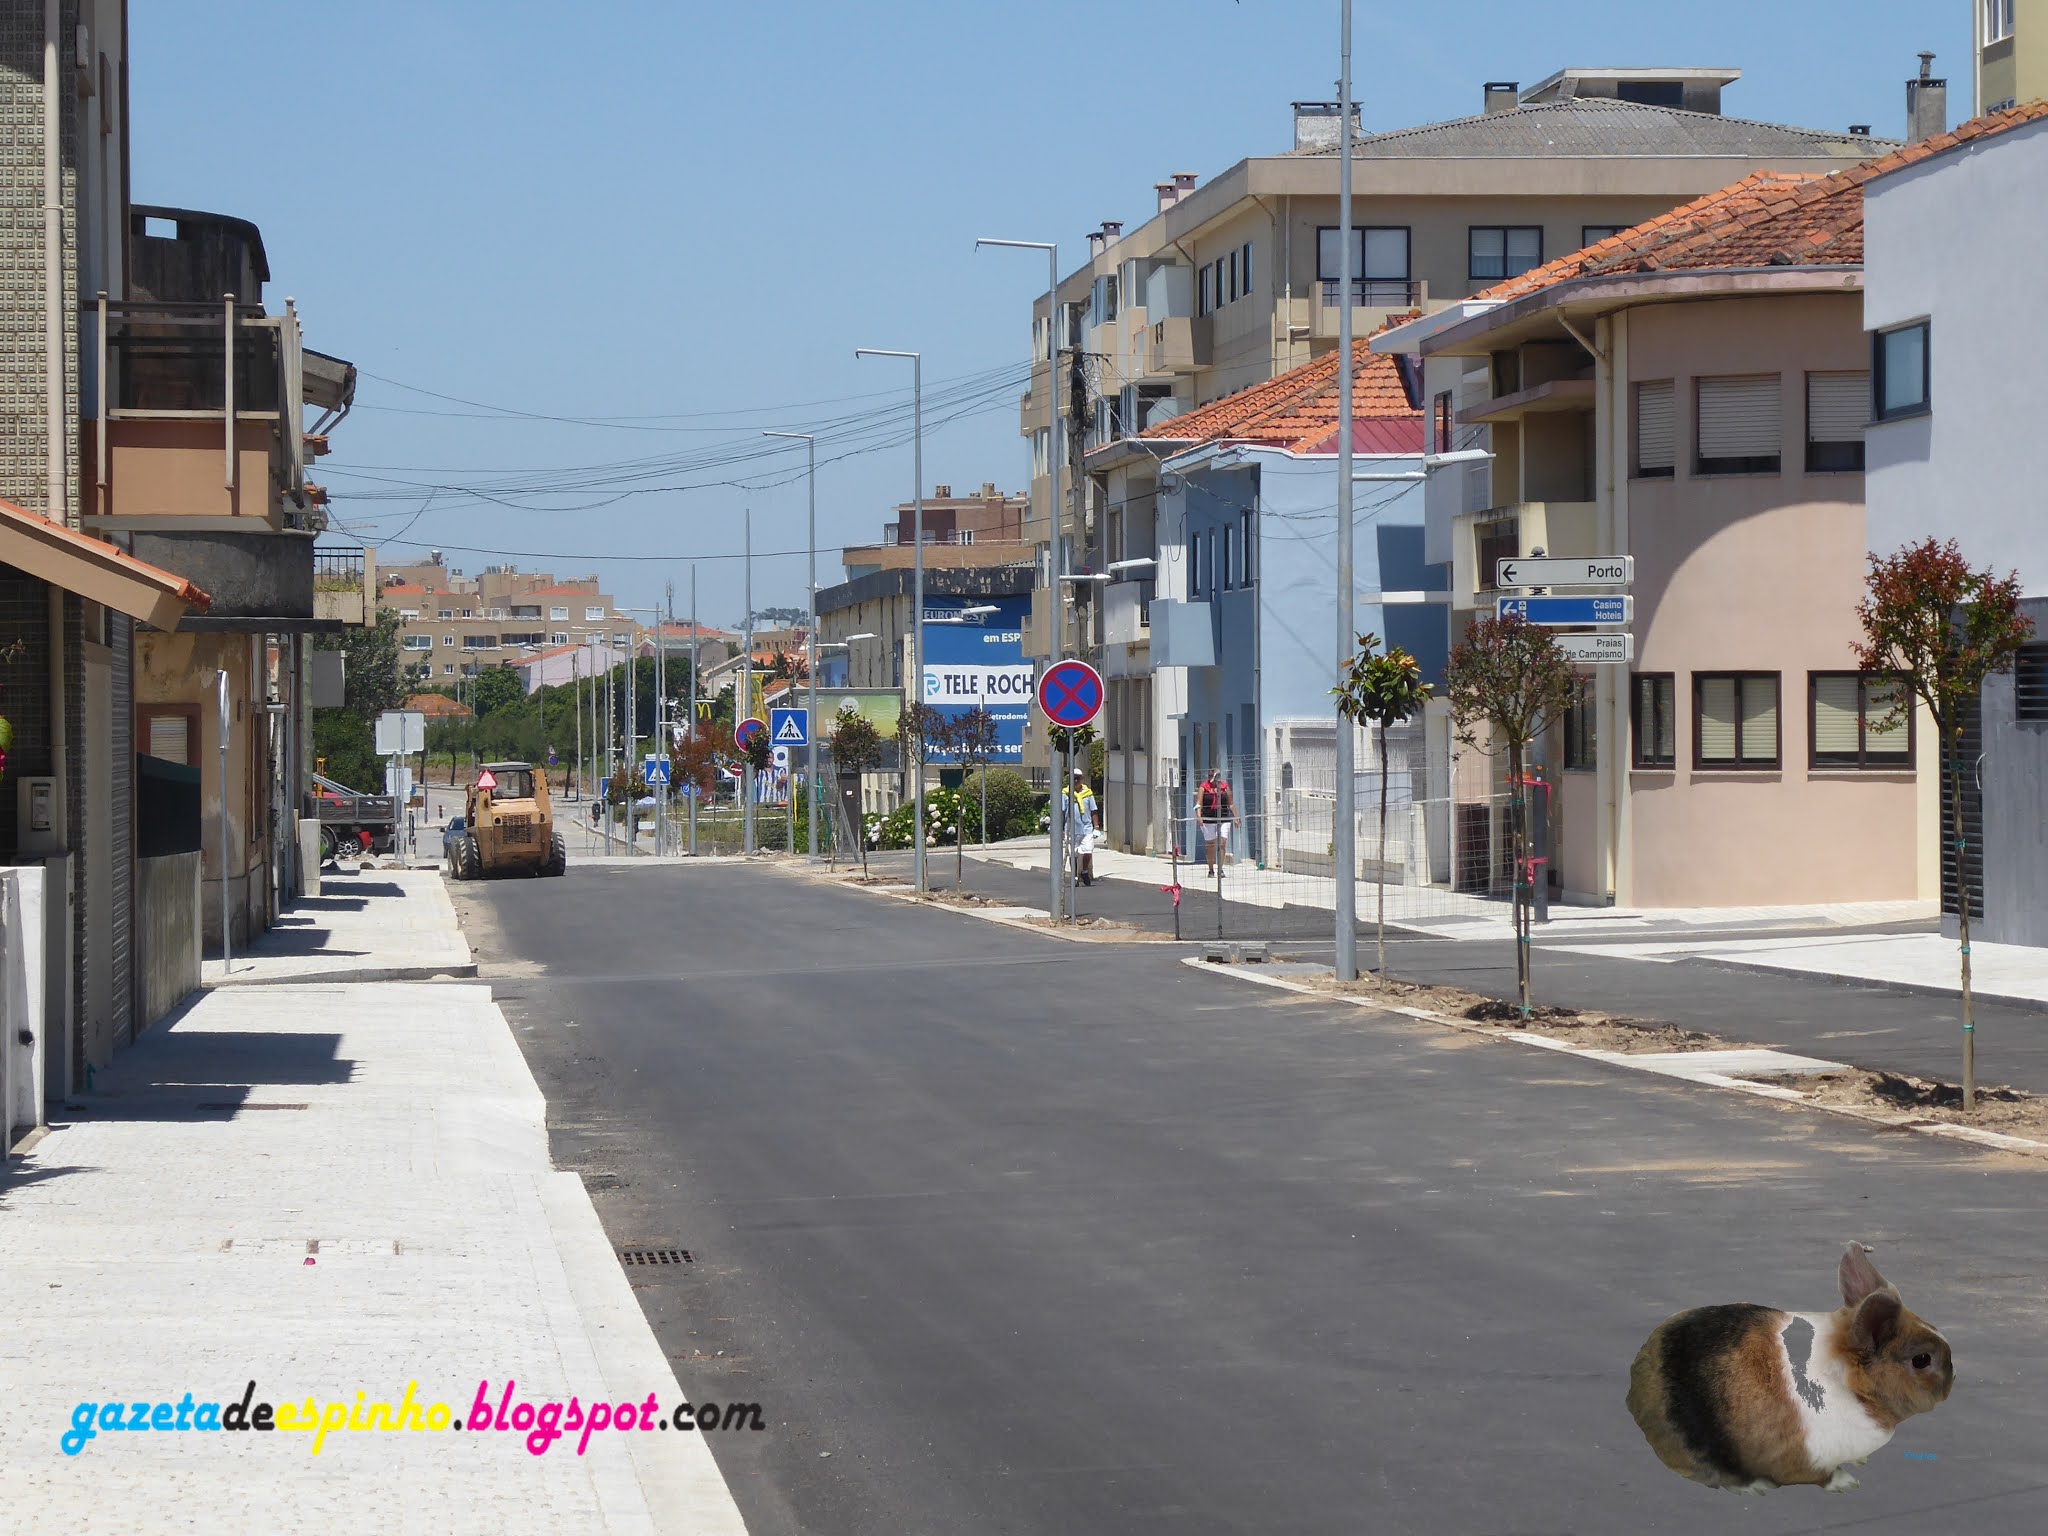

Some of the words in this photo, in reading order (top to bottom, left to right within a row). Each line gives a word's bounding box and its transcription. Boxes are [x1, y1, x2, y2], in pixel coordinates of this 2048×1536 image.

[1588, 565, 1622, 578] Porto
[1593, 600, 1622, 609] Casino
[924, 610, 979, 621] EURONCS
[1595, 611, 1622, 620] Hoteis
[983, 634, 999, 643] em
[1597, 639, 1622, 647] Praias
[1579, 649, 1623, 660] Campismo
[944, 674, 978, 695] TELE
[987, 674, 1034, 694] ROCH
